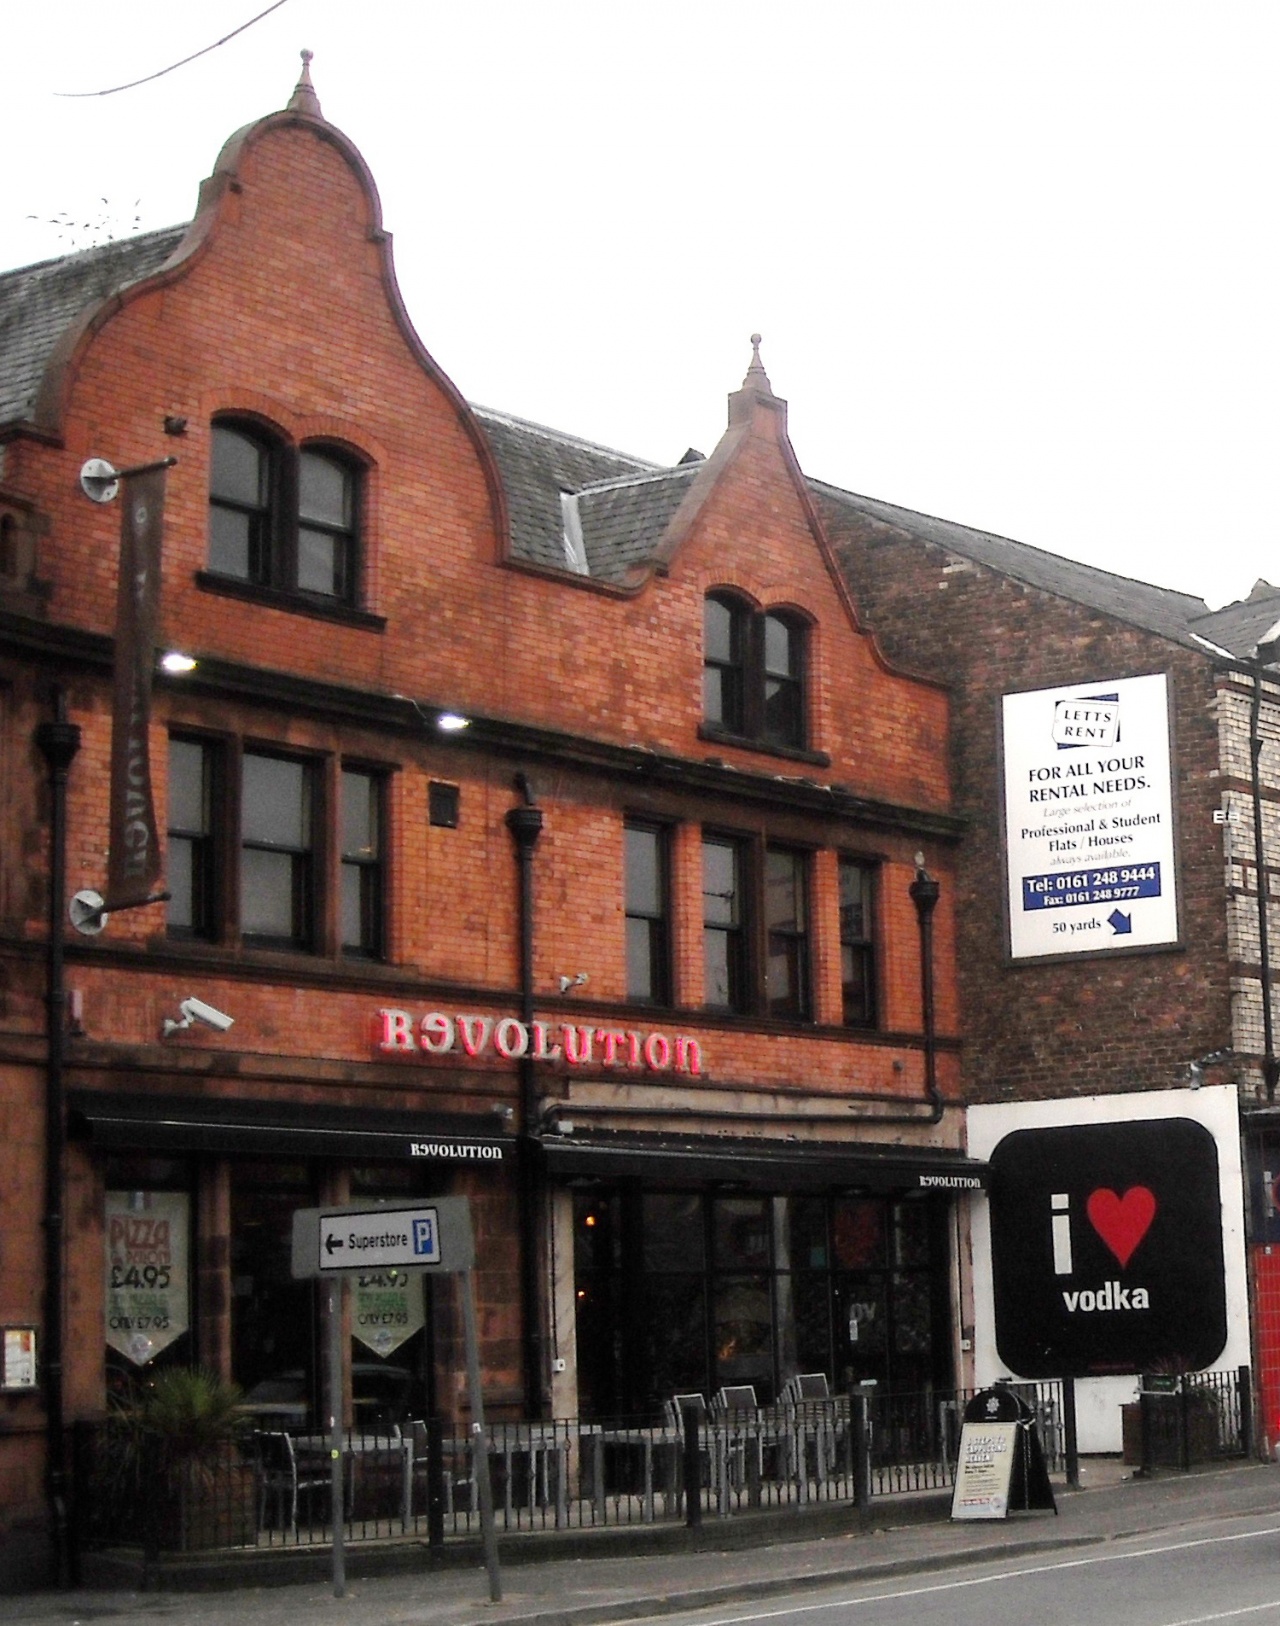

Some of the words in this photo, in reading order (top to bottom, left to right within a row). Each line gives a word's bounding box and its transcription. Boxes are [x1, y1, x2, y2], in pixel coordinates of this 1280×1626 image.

[1064, 710, 1112, 723] LETTS
[1064, 726, 1107, 739] RENT
[1029, 766, 1062, 783] FOR
[1065, 762, 1093, 778] ALL
[1098, 755, 1146, 774] YOUR
[1029, 784, 1088, 803] RENTAL
[1093, 775, 1151, 795] NEEDS.
[1043, 807, 1071, 818] Large
[1074, 800, 1118, 813] selection
[1121, 799, 1132, 808] of
[1021, 819, 1095, 839] Professional
[1099, 819, 1109, 830] &
[1112, 813, 1161, 829] Student
[1049, 840, 1077, 852] Flats
[1088, 833, 1134, 847] Houses
[1049, 854, 1082, 866] always
[1027, 878, 1054, 893] Tel:
[1056, 874, 1088, 890] 0161
[1093, 870, 1118, 886] 248
[1120, 866, 1156, 882] 9444
[1043, 895, 1064, 906] Fax:
[1065, 890, 1090, 904] 0161
[1093, 888, 1112, 902] 248
[1113, 886, 1140, 899] 9777
[1052, 922, 1067, 934] 50
[1070, 917, 1102, 935] yards
[109, 1218, 171, 1250] PIZZA
[348, 1232, 408, 1251] Superstore
[1050, 1193, 1073, 1275] i
[111, 1265, 172, 1289] £4.95
[1062, 1280, 1150, 1312] vodka
